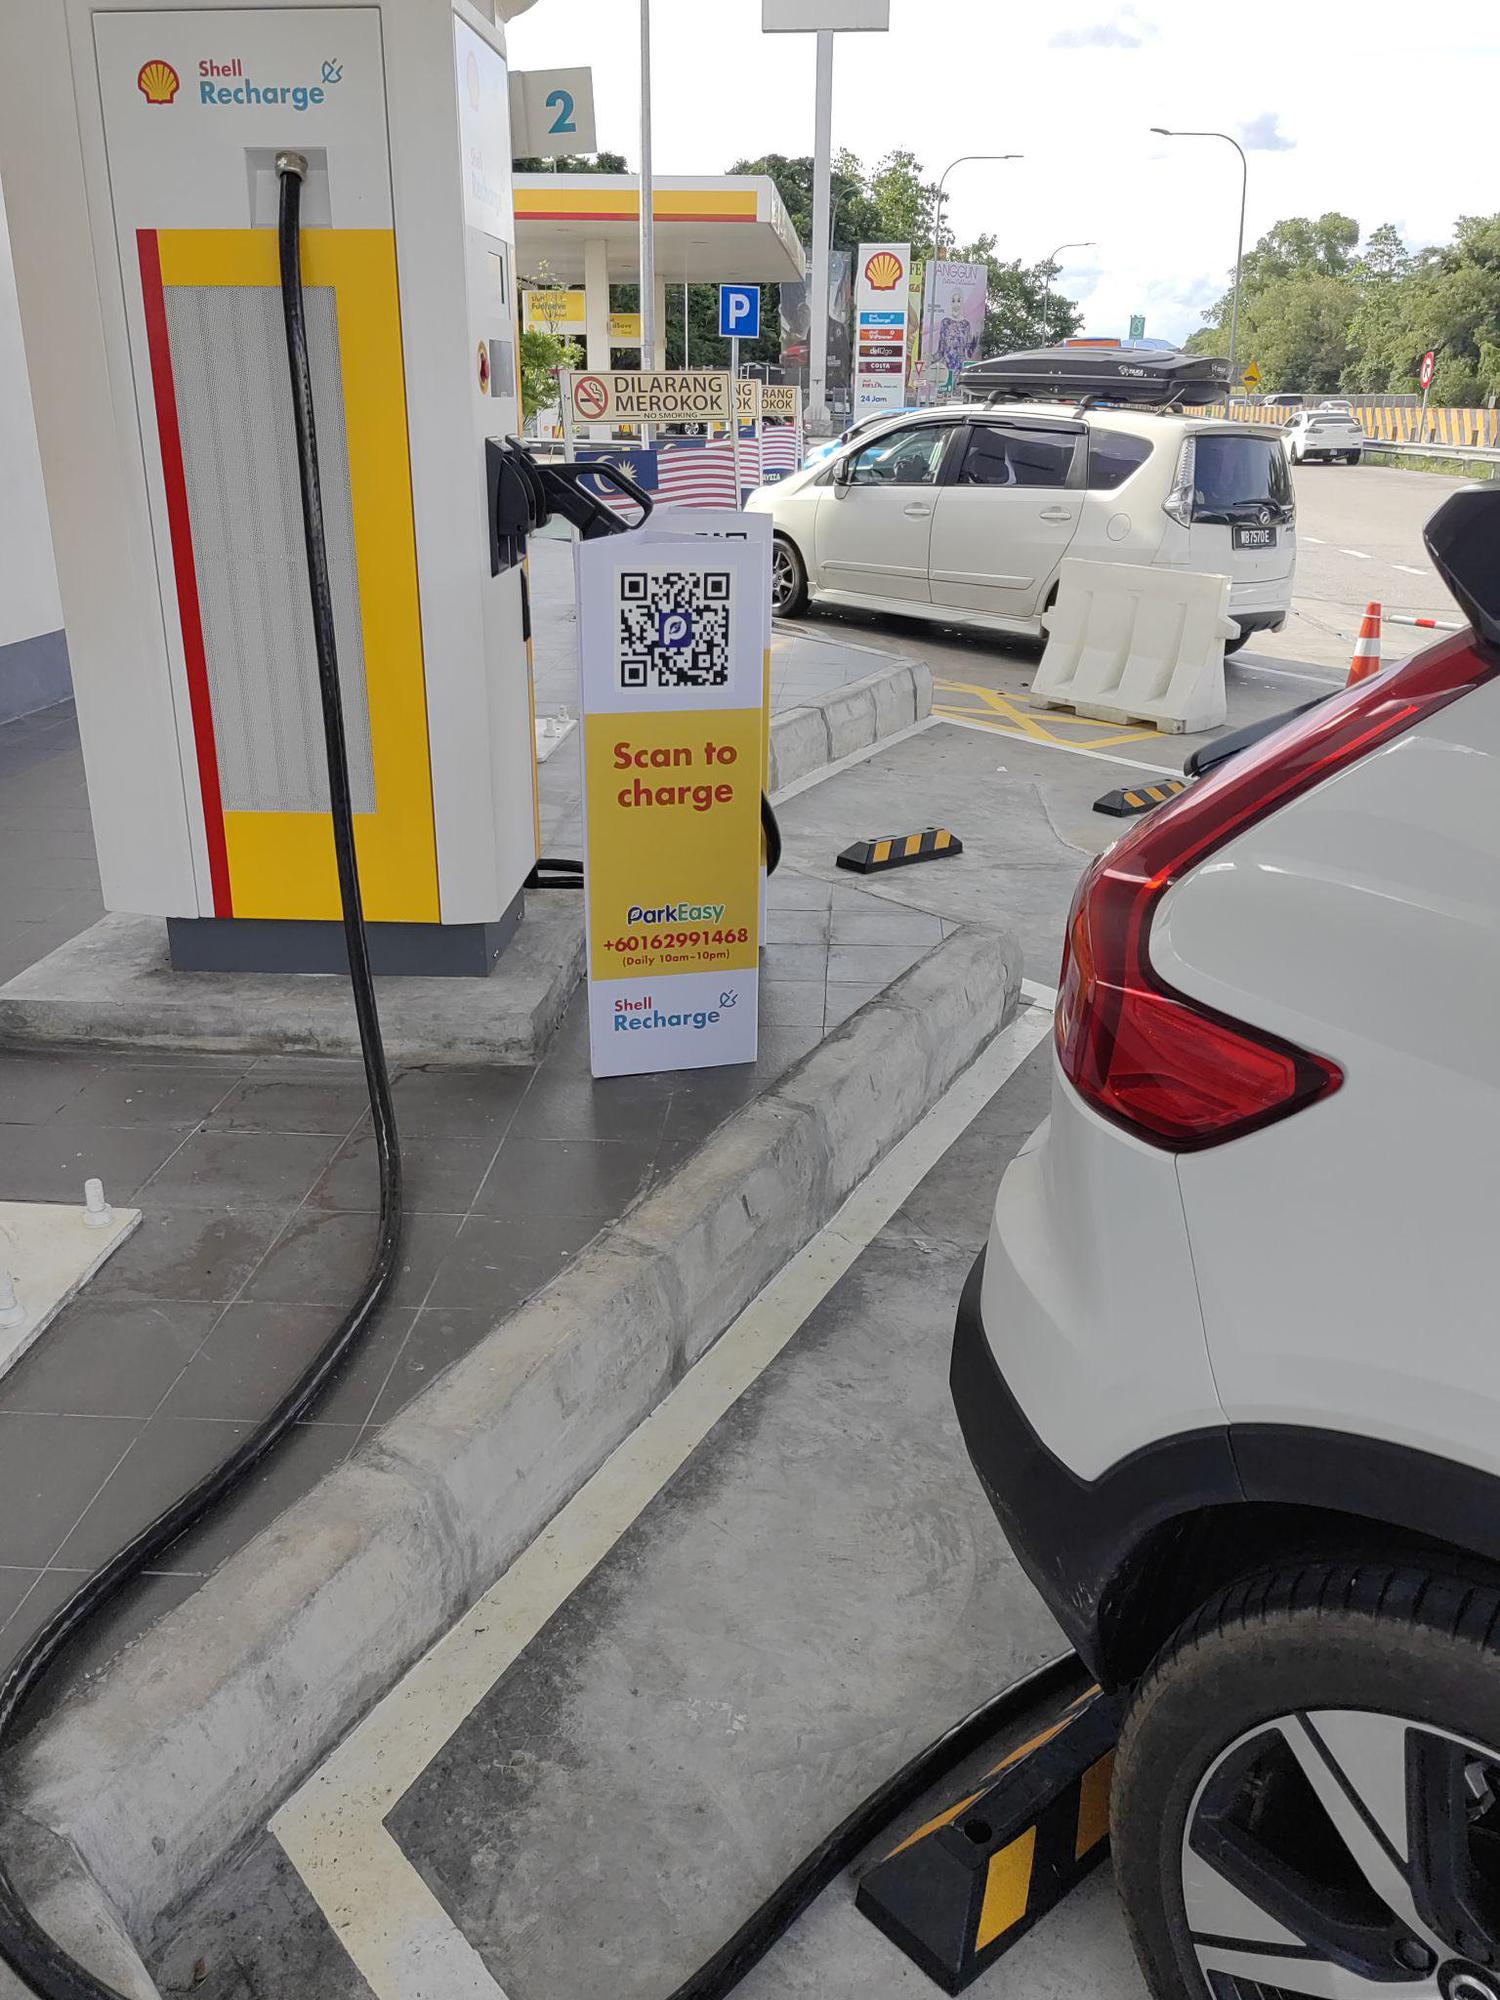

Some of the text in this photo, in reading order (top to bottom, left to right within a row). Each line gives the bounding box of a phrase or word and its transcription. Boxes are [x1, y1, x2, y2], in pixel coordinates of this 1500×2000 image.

[199, 59, 242, 77] Shell
[200, 79, 325, 111] Recharge
[546, 90, 576, 134] 2
[729, 293, 750, 329] P
[614, 376, 722, 393] DILARANG
[762, 389, 793, 399] RANG
[615, 394, 722, 412] MEROKOK
[659, 411, 698, 419] SMOKING
[613, 741, 738, 770] Scan to
[617, 778, 734, 812] charge
[627, 903, 725, 926] ParkEasy
[603, 927, 749, 953] +60162991468
[622, 955, 655, 968] (Daily
[614, 996, 652, 1012] Shell
[614, 1009, 721, 1032] Recharge
